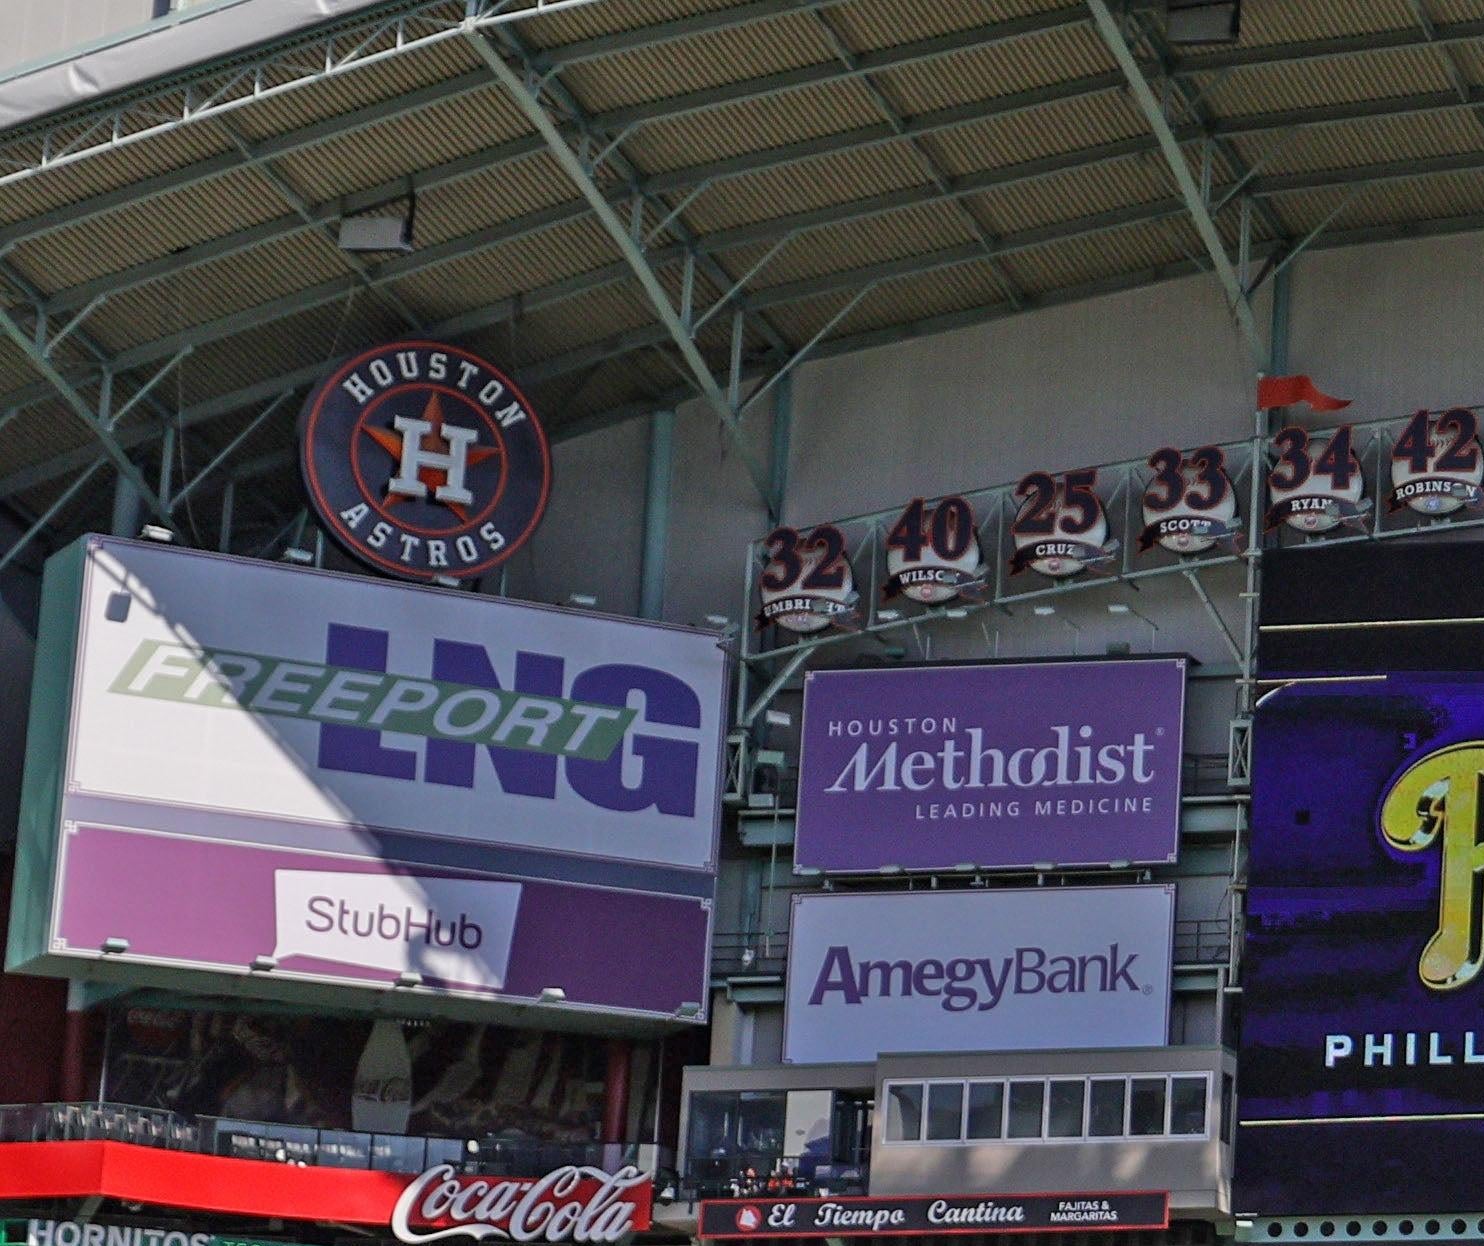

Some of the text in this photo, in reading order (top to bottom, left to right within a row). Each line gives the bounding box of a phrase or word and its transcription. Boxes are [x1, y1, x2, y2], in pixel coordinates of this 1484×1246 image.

[343, 349, 527, 429] HOUSTON
[384, 415, 481, 504] H
[1268, 424, 1359, 492] 34
[1391, 408, 1480, 473] 42
[1012, 469, 1099, 536] 25
[1143, 446, 1227, 512] 33
[1291, 498, 1333, 512] RYAN
[1396, 481, 1477, 500] ROBINSN
[339, 502, 507, 566] ASTROS
[760, 523, 846, 591] 32
[886, 498, 972, 562] 40
[1035, 543, 1076, 555] CRUZ
[899, 570, 961, 585] WILSO
[127, 645, 619, 755] FREEPORT
[318, 622, 702, 818] LNG
[828, 717, 958, 737] HOUSTON
[823, 724, 1155, 792] Methodist
[915, 796, 1153, 819] LEADING MEDICINE
[305, 896, 483, 949] StubHub
[808, 943, 1151, 1012] AmegyBank
[391, 1164, 651, 1244] Coca-Cola
[767, 1200, 1025, 1231] El Tiempo Cantina
[1049, 1210, 1118, 1222] MARGARITAS
[1058, 1202, 1098, 1212] FAJITAS
